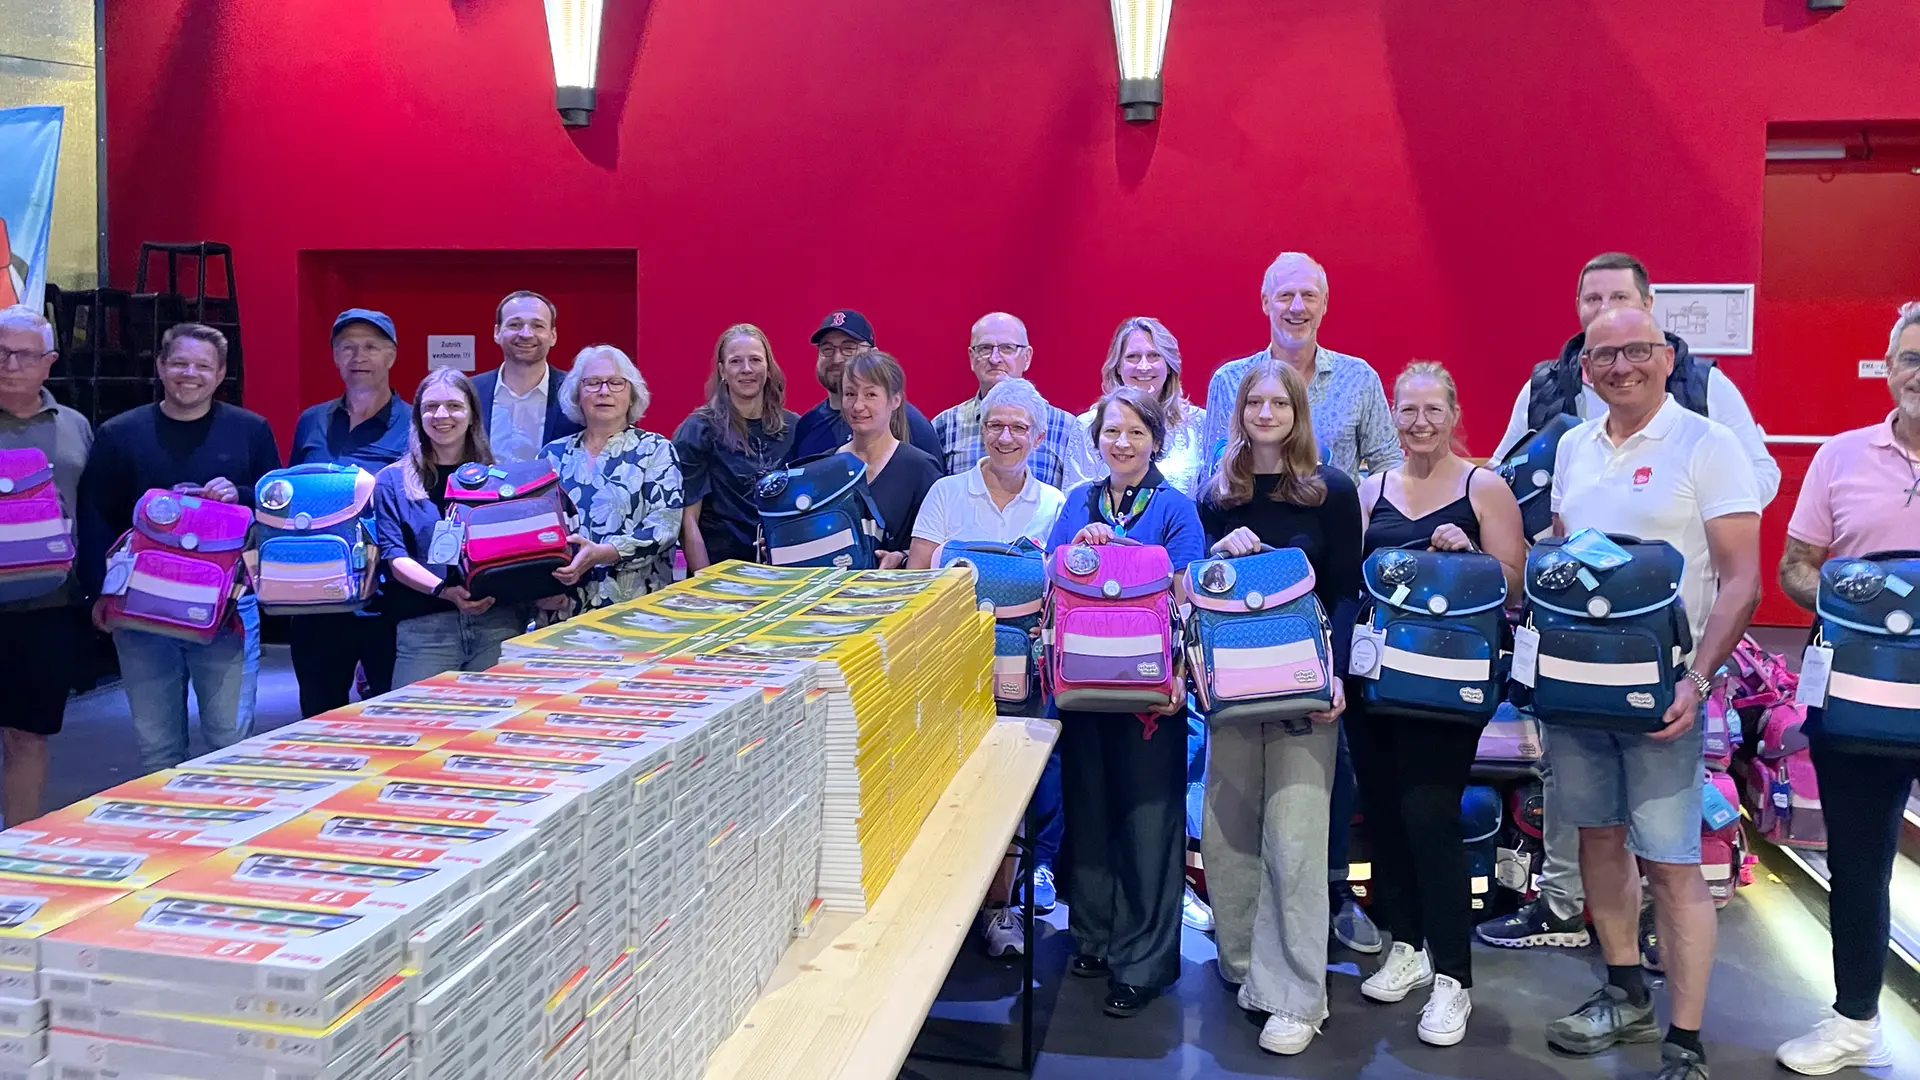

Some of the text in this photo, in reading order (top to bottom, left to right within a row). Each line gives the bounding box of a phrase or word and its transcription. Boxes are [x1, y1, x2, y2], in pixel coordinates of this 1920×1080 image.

[440, 340, 462, 349] Zutritt
[432, 352, 461, 360] verboten
[446, 810, 478, 821] 12
[391, 847, 425, 860] 12
[309, 889, 349, 904] 12
[214, 941, 258, 958] 12
